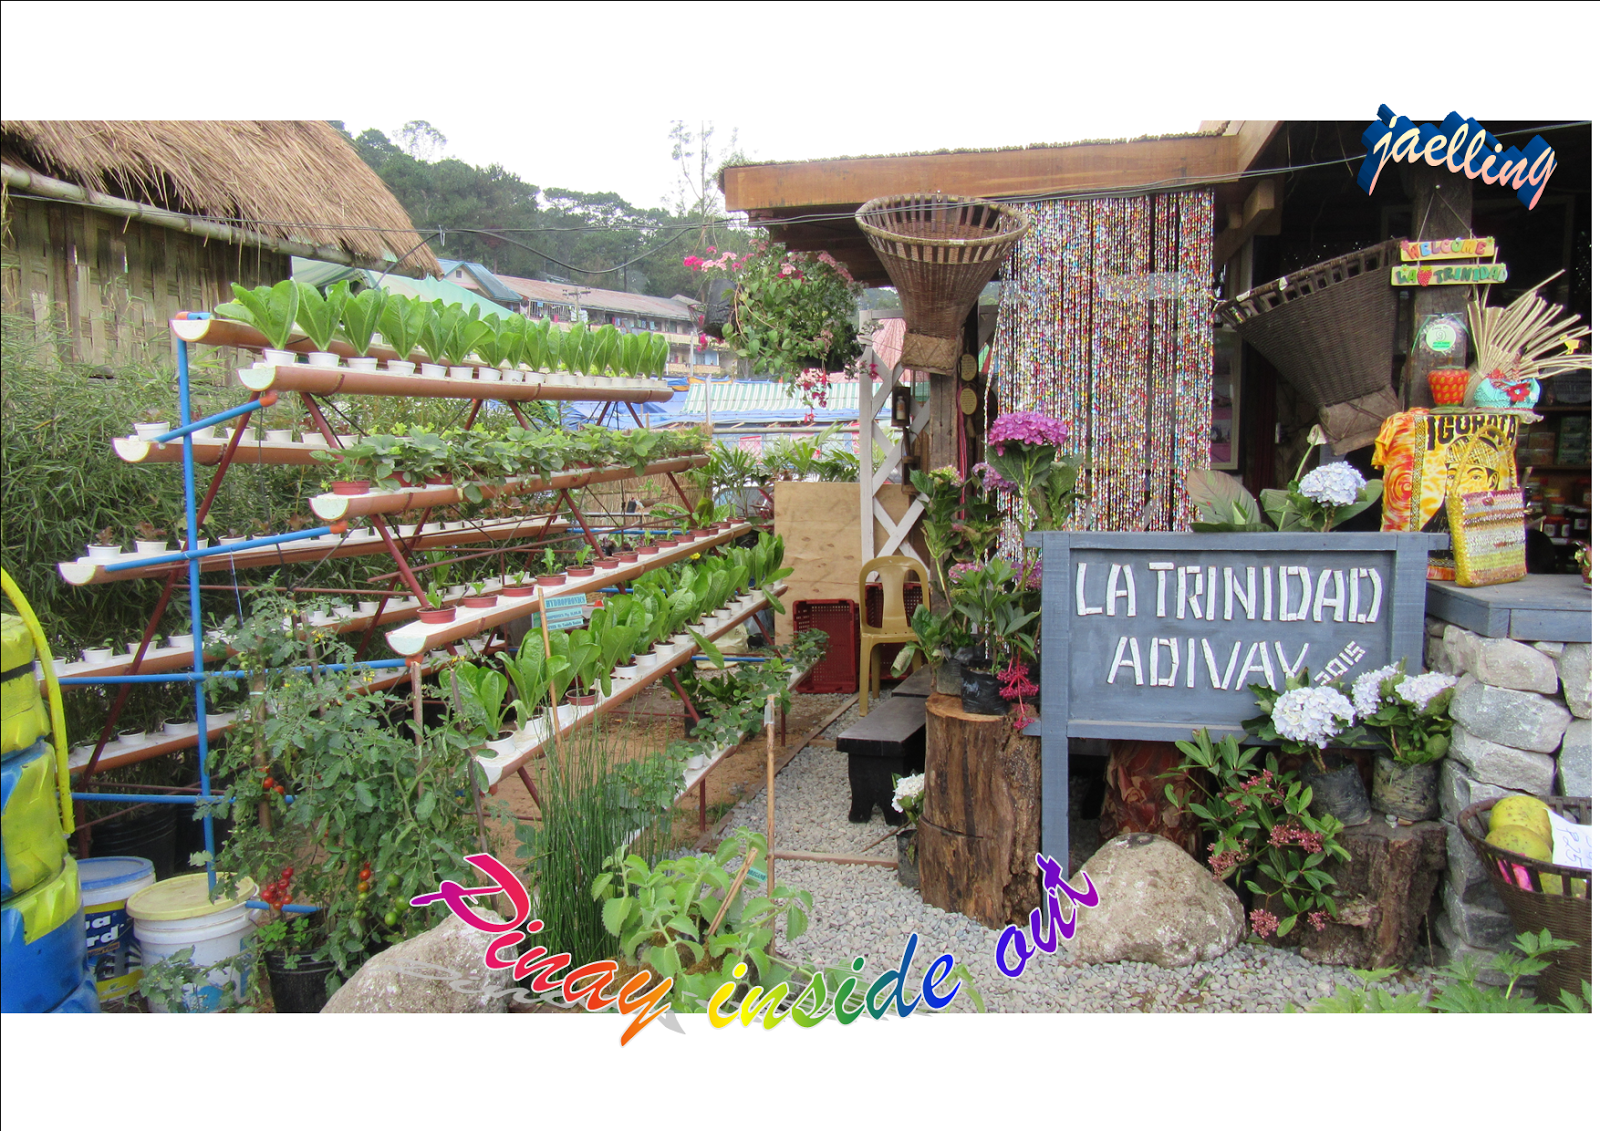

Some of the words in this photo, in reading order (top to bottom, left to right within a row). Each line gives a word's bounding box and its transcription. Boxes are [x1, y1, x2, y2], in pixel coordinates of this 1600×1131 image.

[1407, 239, 1487, 259] WELCOME
[1396, 269, 1417, 284] LA
[1433, 266, 1508, 284] TRINIDAD
[1076, 562, 1137, 617] LA
[1148, 562, 1382, 623] TRINIDAD
[1107, 636, 1309, 691] ADIVAY
[1313, 640, 1366, 686] 2015
